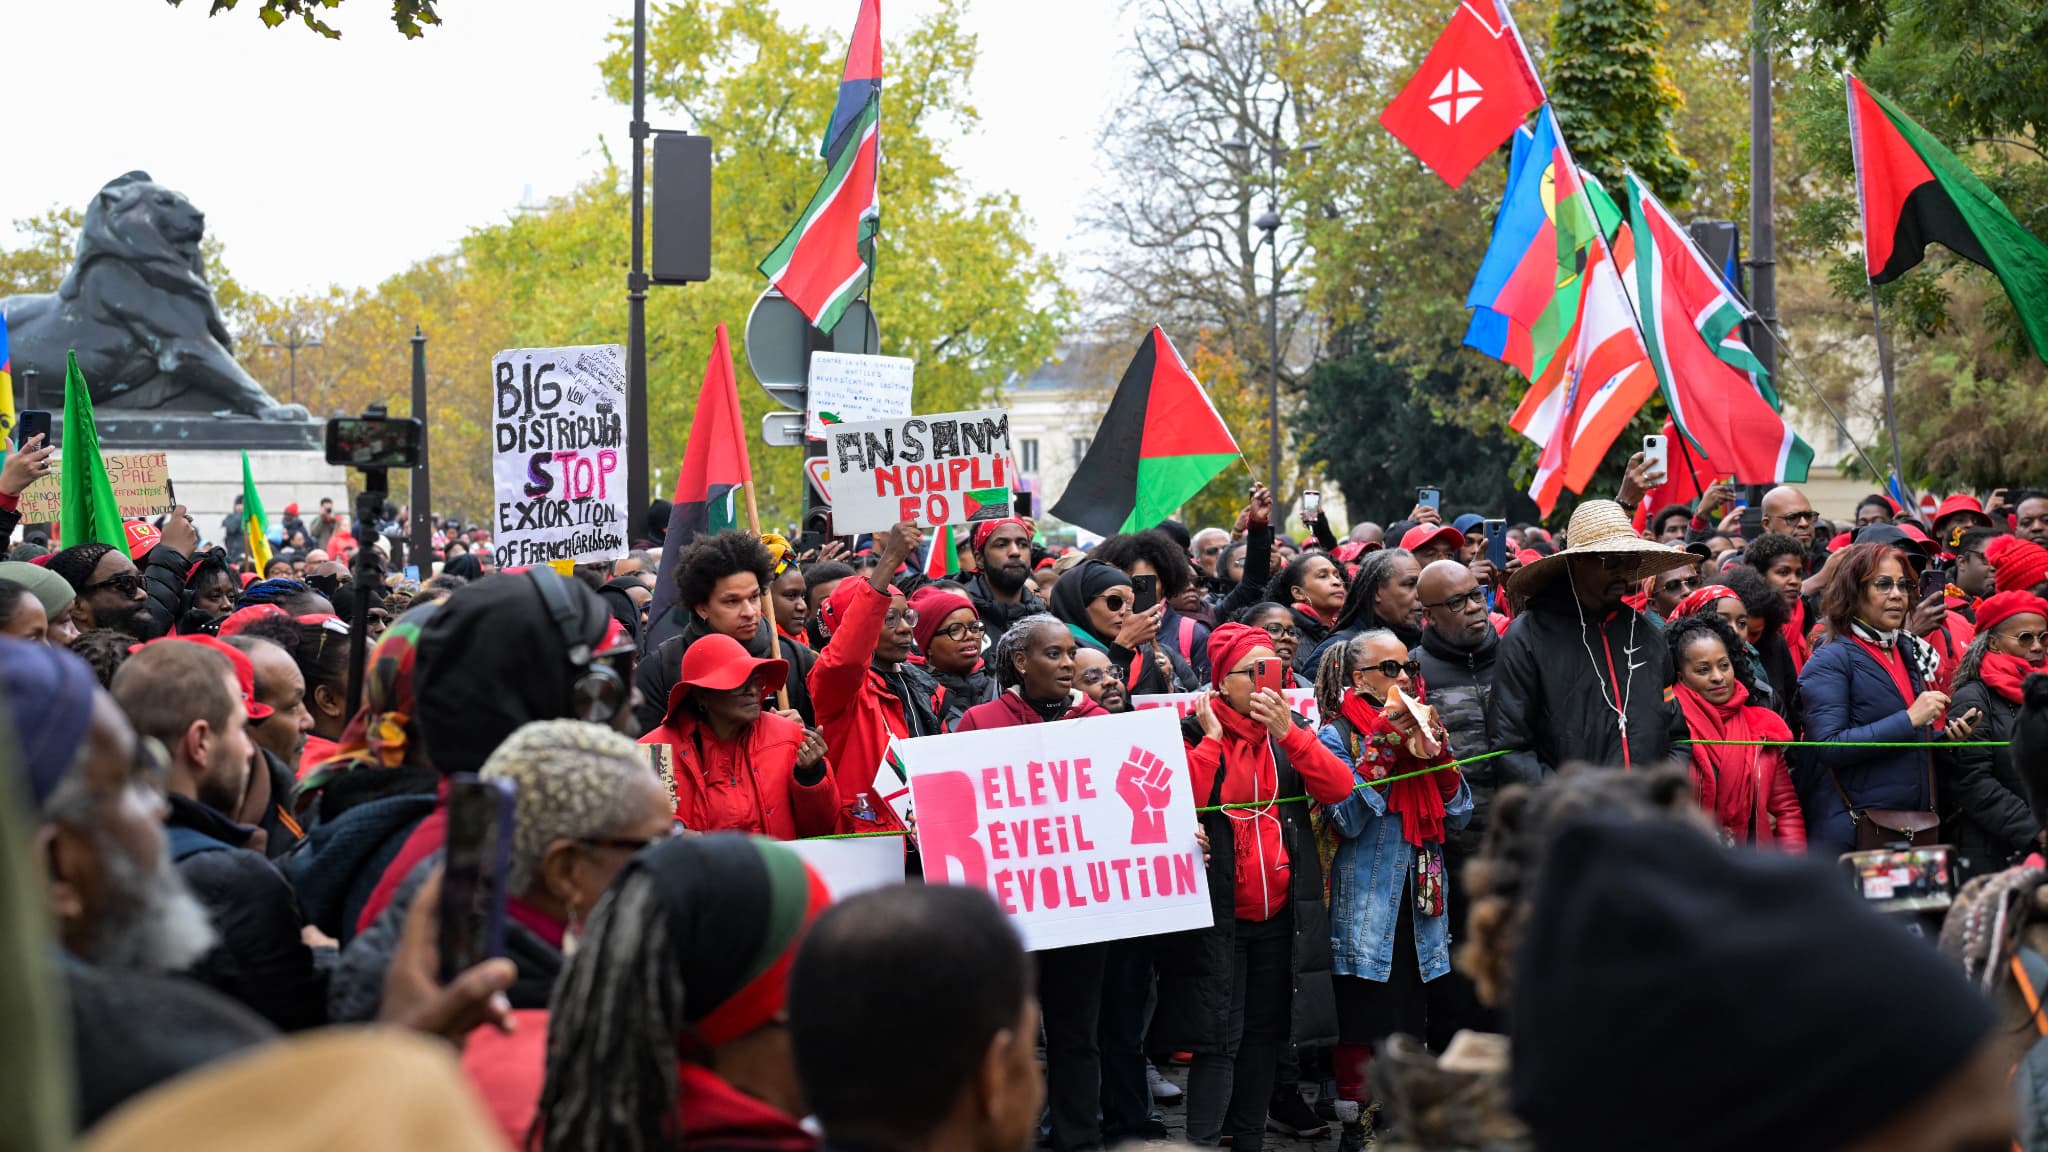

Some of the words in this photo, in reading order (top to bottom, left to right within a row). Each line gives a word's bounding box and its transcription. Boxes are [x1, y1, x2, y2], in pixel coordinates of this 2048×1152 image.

[496, 355, 562, 419] BIG
[835, 413, 1010, 473] ANSANM
[524, 450, 617, 499] STOP
[495, 541, 518, 567] OF
[520, 539, 572, 566] FRENCH
